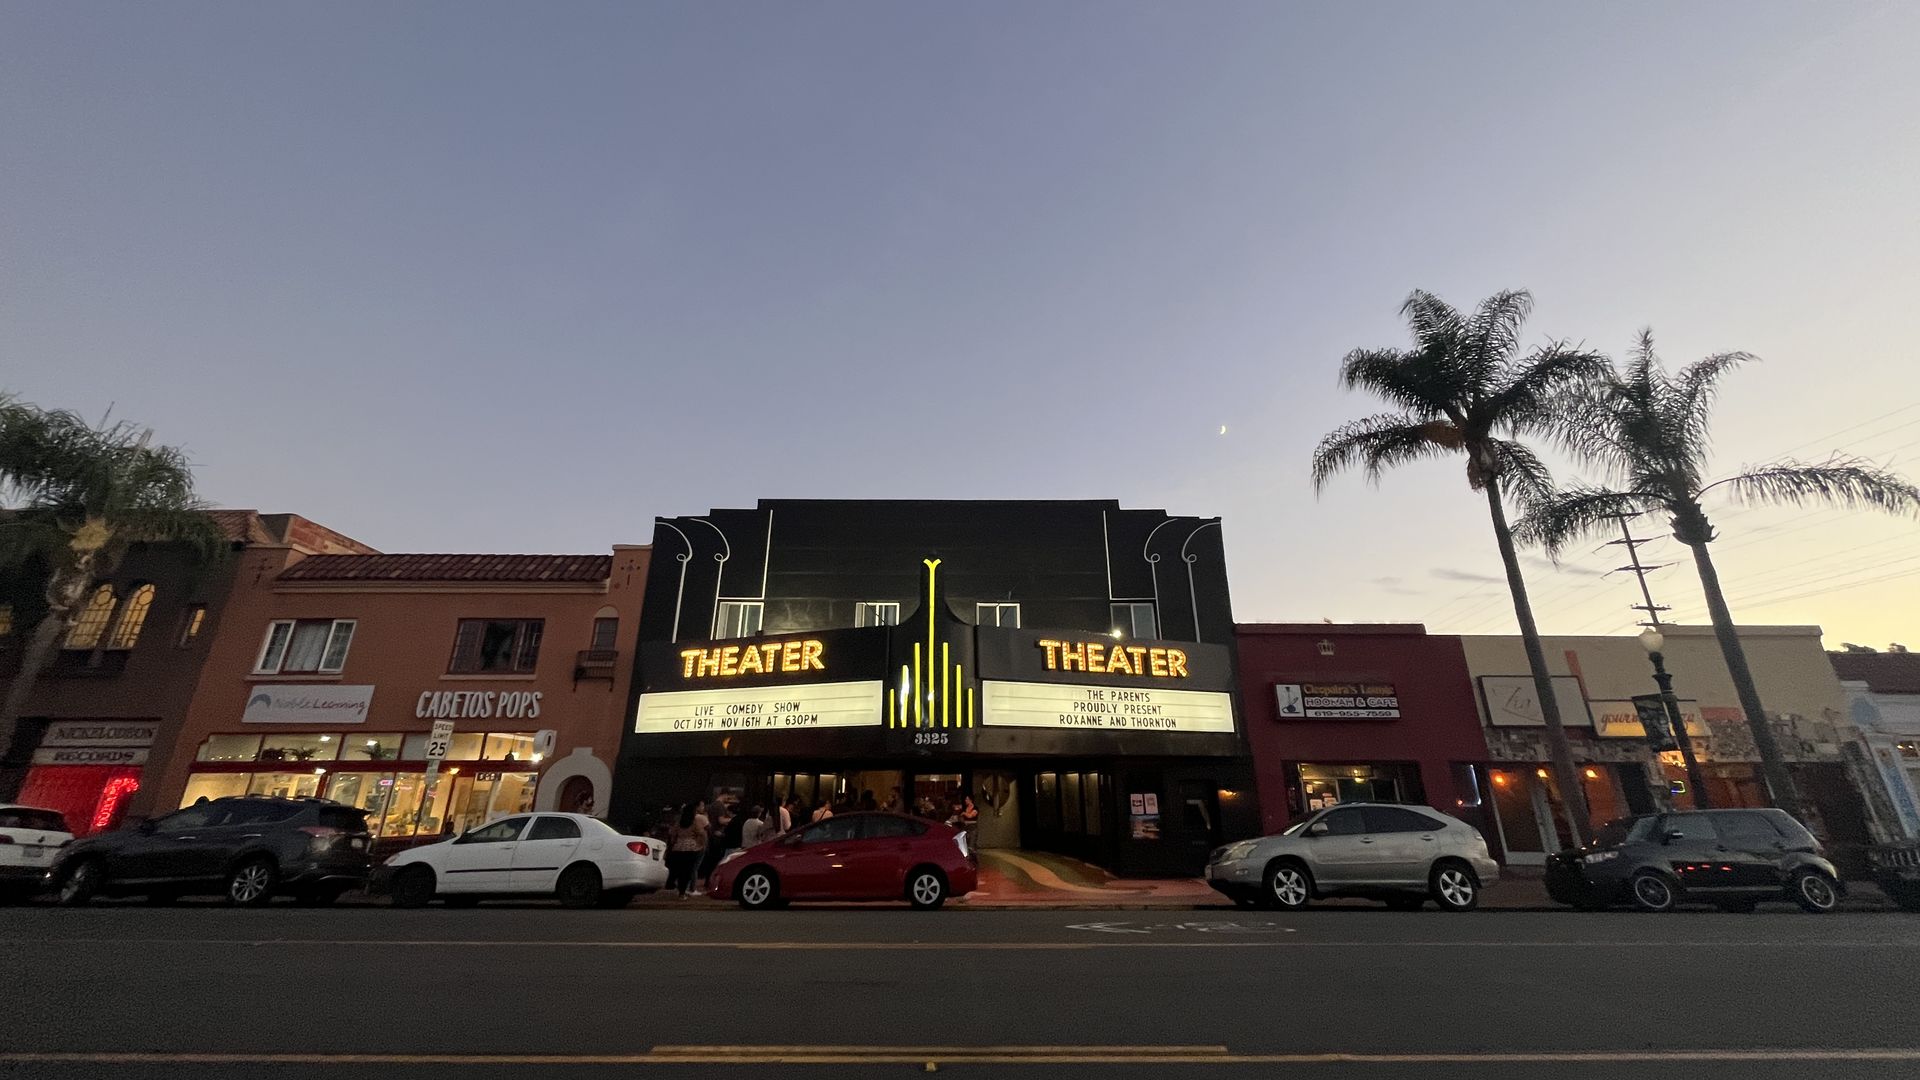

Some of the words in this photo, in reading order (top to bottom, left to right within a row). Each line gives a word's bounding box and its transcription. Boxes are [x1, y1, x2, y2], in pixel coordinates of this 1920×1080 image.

[681, 640, 825, 678] THEATER
[1039, 640, 1188, 677] THEATER
[1087, 689, 1105, 700] THE
[1111, 691, 1151, 703] PARENTS
[1304, 697, 1355, 707] HOOKAH
[1366, 698, 1399, 708] CAFE
[415, 690, 496, 719] CABETOS
[496, 690, 543, 719] POPS
[694, 705, 714, 717] LIVE
[726, 704, 763, 715] COMEDY
[774, 702, 800, 713] SHOW
[1073, 702, 1118, 713] PROUDLY
[1124, 704, 1163, 715] PRESENT
[434, 723, 452, 731] SPEED
[673, 719, 690, 730] OCT
[693, 719, 714, 729] 19TH
[720, 718, 739, 728] NOV
[741, 717, 761, 727] 16TH
[766, 716, 778, 727] AT
[785, 715, 818, 726] 630PM
[1059, 714, 1103, 726] ROXANNE
[1109, 717, 1128, 727] AND
[1131, 717, 1177, 729] THORNTON
[433, 732, 449, 740] LIMIT
[914, 732, 949, 745] 3325
[428, 741, 446, 757] 25
